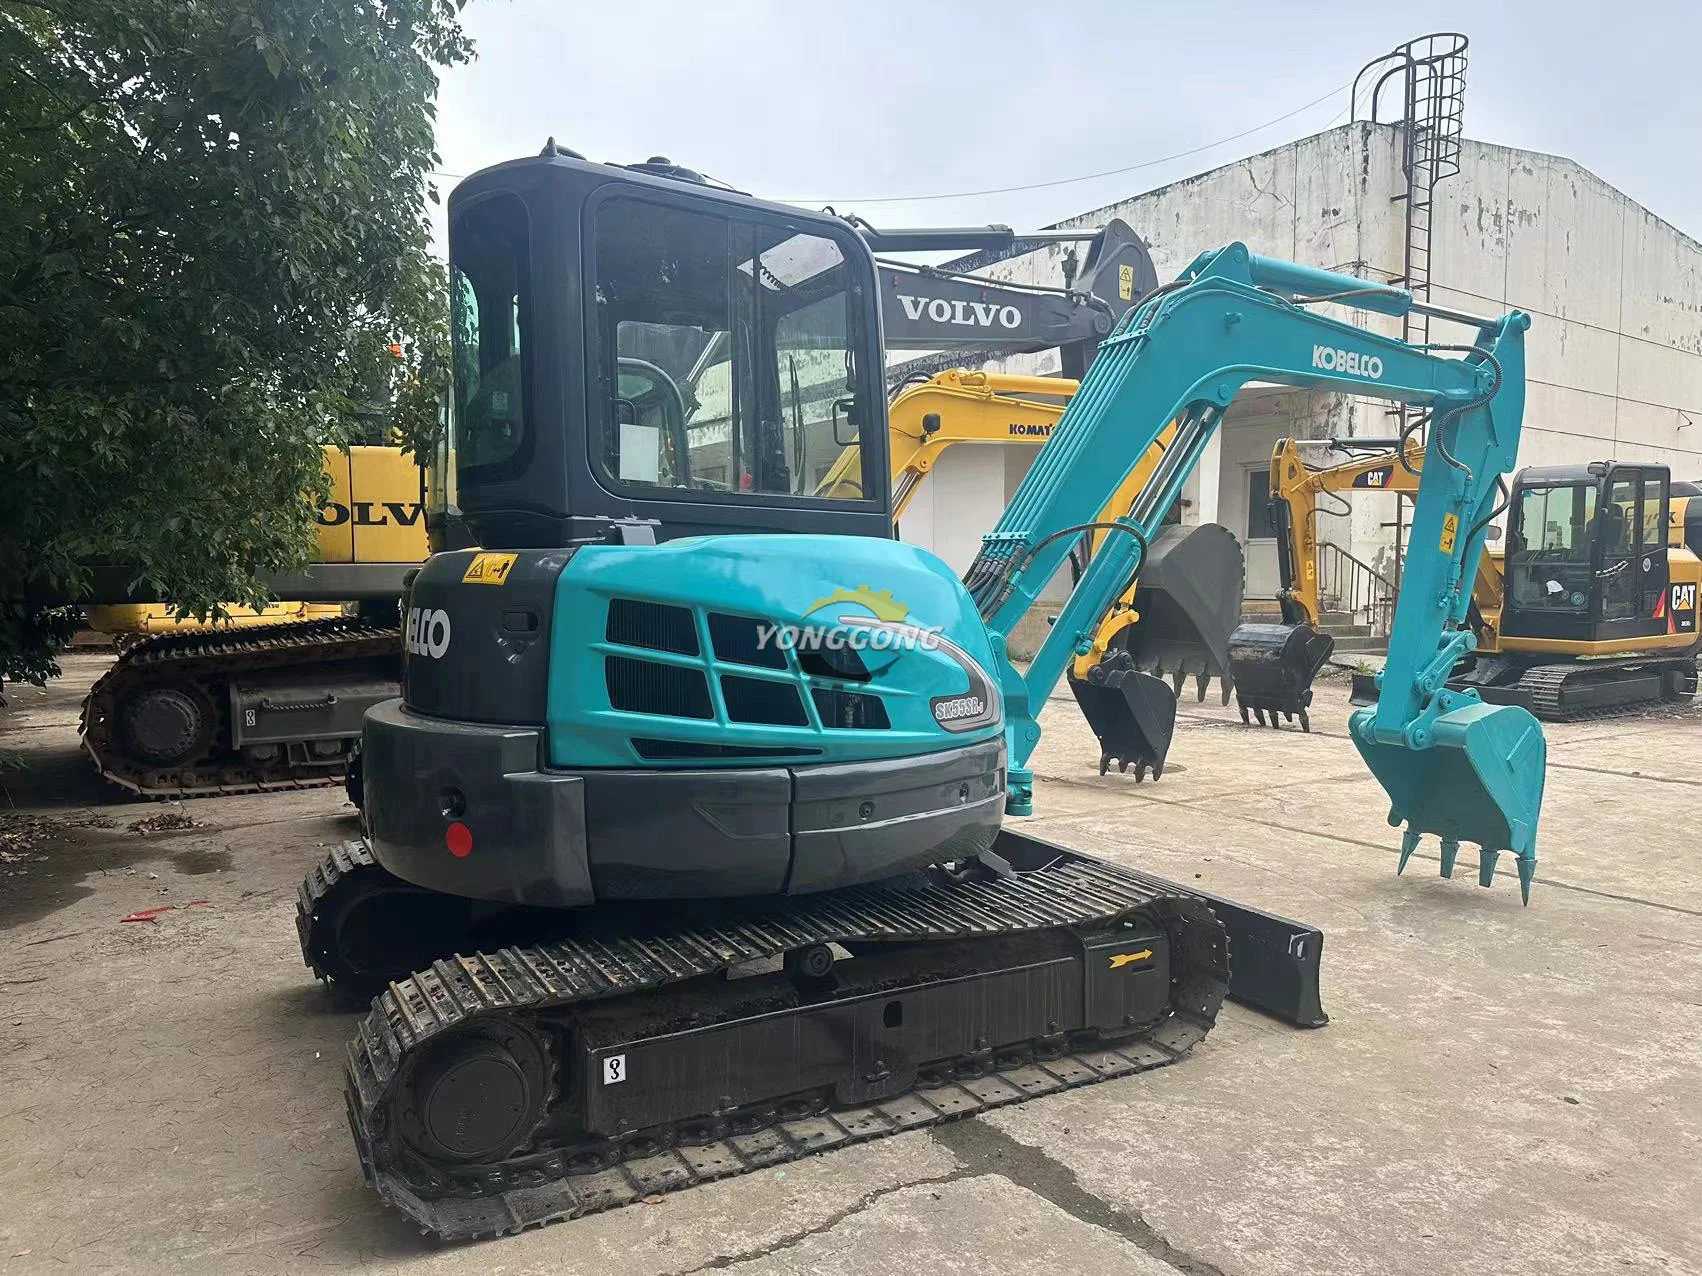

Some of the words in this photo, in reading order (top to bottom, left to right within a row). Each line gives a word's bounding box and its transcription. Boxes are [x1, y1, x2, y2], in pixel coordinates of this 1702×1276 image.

[897, 295, 1021, 328] VOLVO
[1312, 345, 1383, 379] KOBELCO
[1009, 423, 1056, 436] KOMAT
[1367, 471, 1384, 486] CAT
[1671, 585, 1696, 610] CAT
